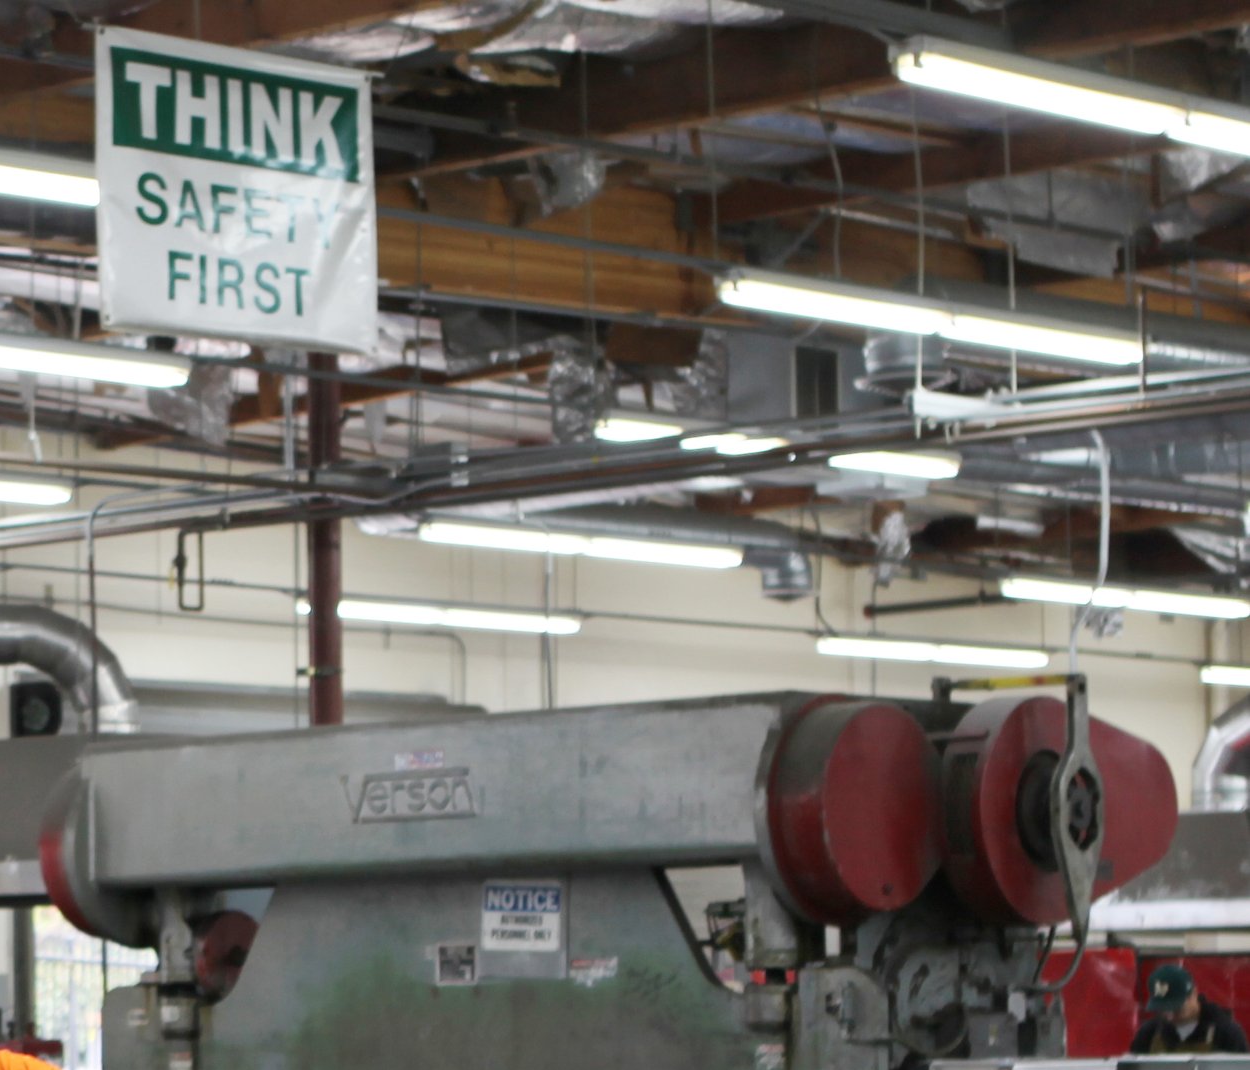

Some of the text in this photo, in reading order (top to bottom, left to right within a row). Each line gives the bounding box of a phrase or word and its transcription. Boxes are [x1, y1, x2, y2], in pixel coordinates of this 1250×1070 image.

[125, 61, 345, 171] THINK
[136, 172, 341, 250] SAFETY
[168, 251, 310, 317] FIRST
[339, 768, 477, 824] Verson
[486, 889, 558, 911] NOTICE
